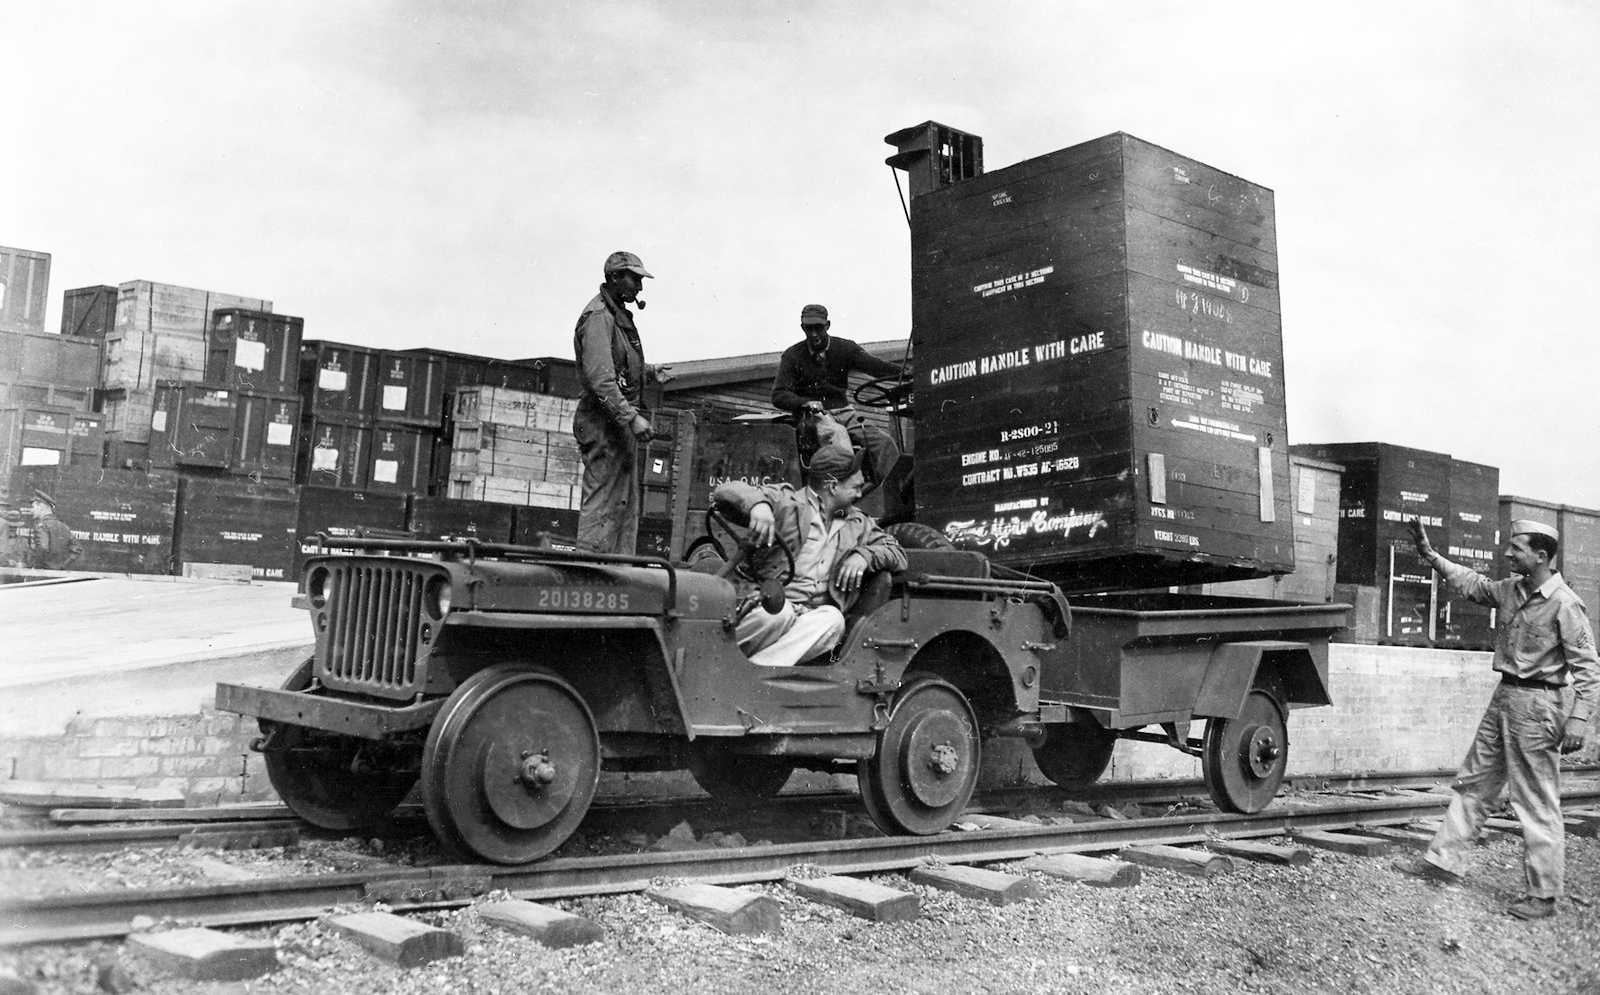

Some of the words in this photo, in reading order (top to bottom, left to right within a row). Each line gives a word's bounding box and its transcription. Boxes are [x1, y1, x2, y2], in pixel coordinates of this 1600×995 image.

[931, 360, 976, 385] CAUTION
[981, 348, 1029, 374] HANDLE
[1035, 340, 1065, 362] WITH
[1070, 331, 1104, 354] CARE
[1142, 329, 1183, 356] CAUTION
[1185, 340, 1222, 365] HANDLE
[1225, 351, 1247, 372] WITH
[1249, 357, 1272, 378] CARE
[962, 451, 987, 467] ENGINE
[989, 449, 1003, 462] NO.
[962, 469, 1000, 486] CONTRACT
[1040, 497, 1049, 506] BY
[1348, 509, 1365, 518] CARE
[1031, 508, 1108, 538] Company
[93, 532, 119, 543] HANDLE
[122, 534, 139, 543] WITH
[142, 535, 160, 545] CARE
[266, 569, 284, 578] CARE
[538, 590, 629, 610] 20138285
[689, 595, 698, 611] S
